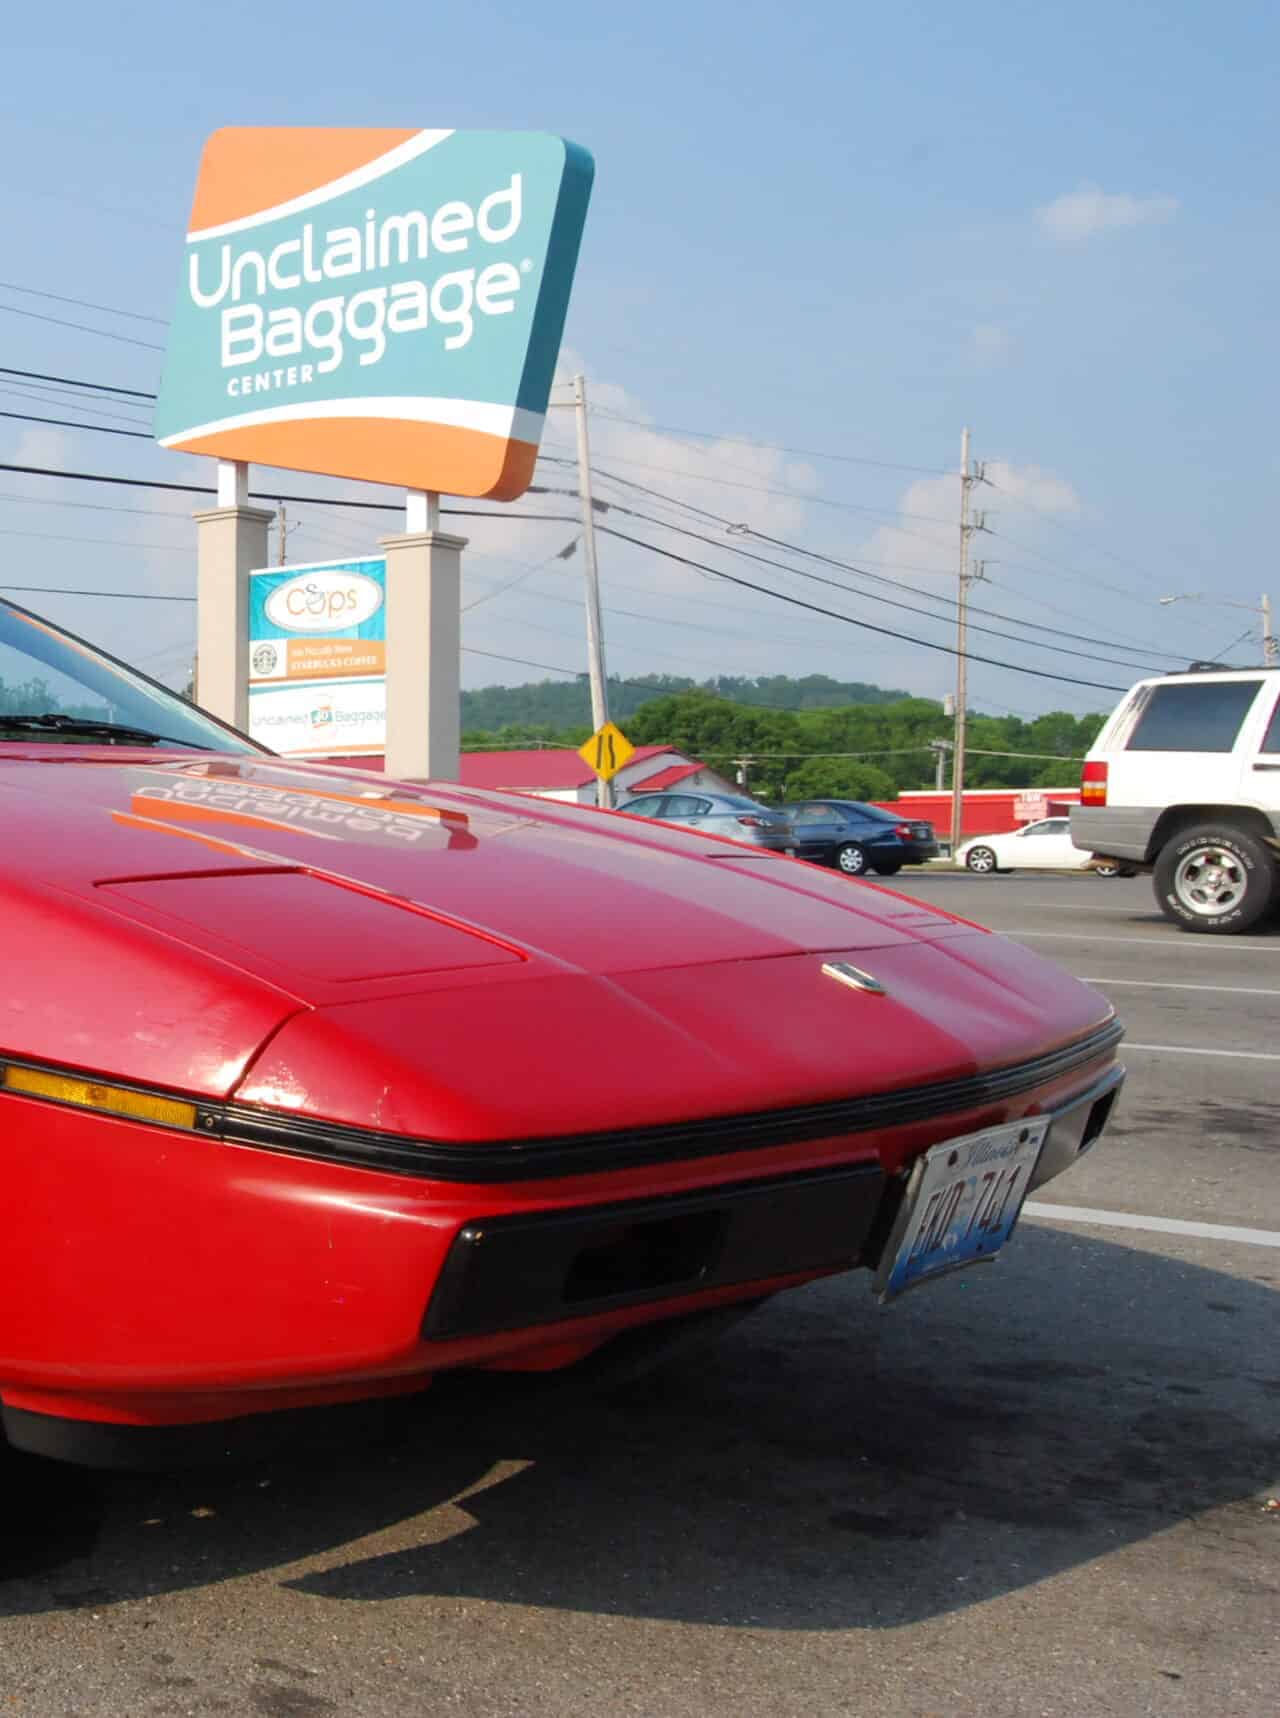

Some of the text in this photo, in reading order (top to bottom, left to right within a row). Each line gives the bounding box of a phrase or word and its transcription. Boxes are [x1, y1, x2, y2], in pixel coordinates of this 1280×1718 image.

[188, 173, 522, 308] Unclaimed
[220, 258, 521, 374] Baggage
[226, 363, 314, 397] CENTER
[964, 1165, 1021, 1240] 741
